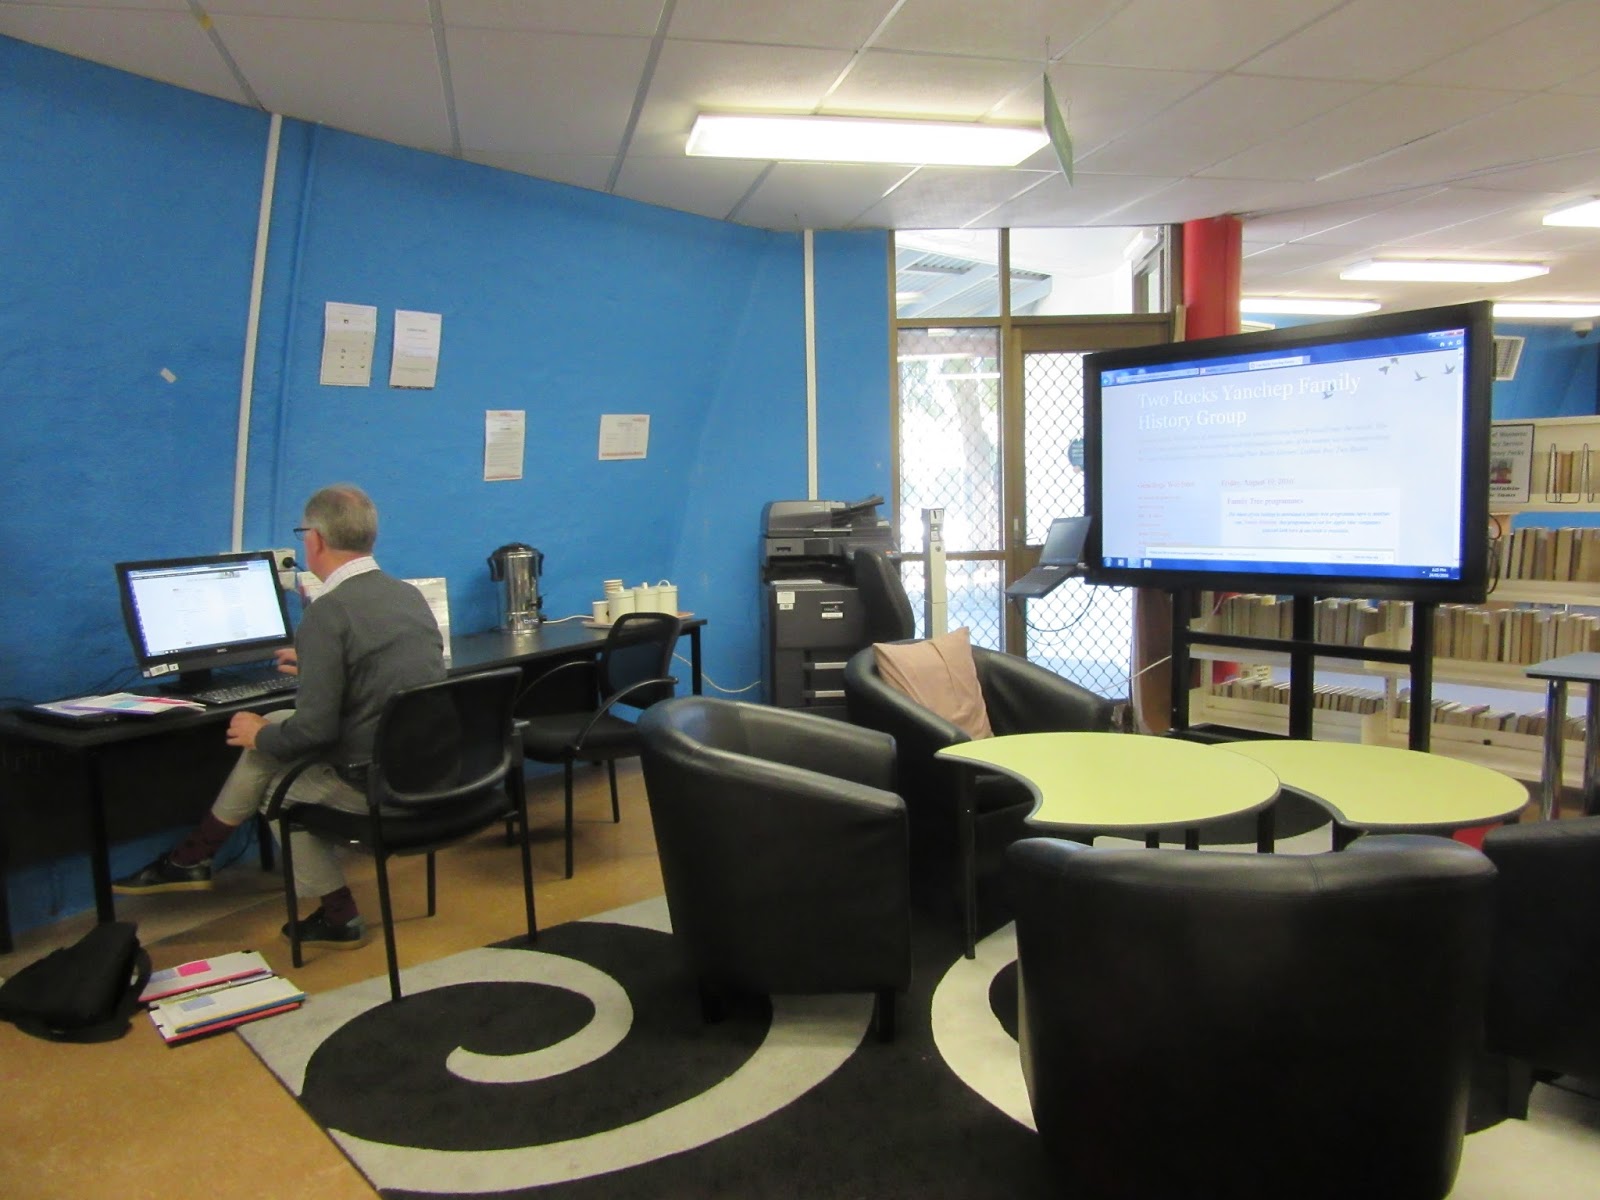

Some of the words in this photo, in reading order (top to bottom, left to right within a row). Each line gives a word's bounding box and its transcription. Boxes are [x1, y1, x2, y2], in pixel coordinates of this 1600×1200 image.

[1137, 392, 1169, 409] Two
[1173, 387, 1219, 406] Rocks
[1222, 379, 1294, 401] Yanchep
[1298, 372, 1361, 395] Family
[1137, 413, 1193, 432] History
[1197, 409, 1248, 428] Group
